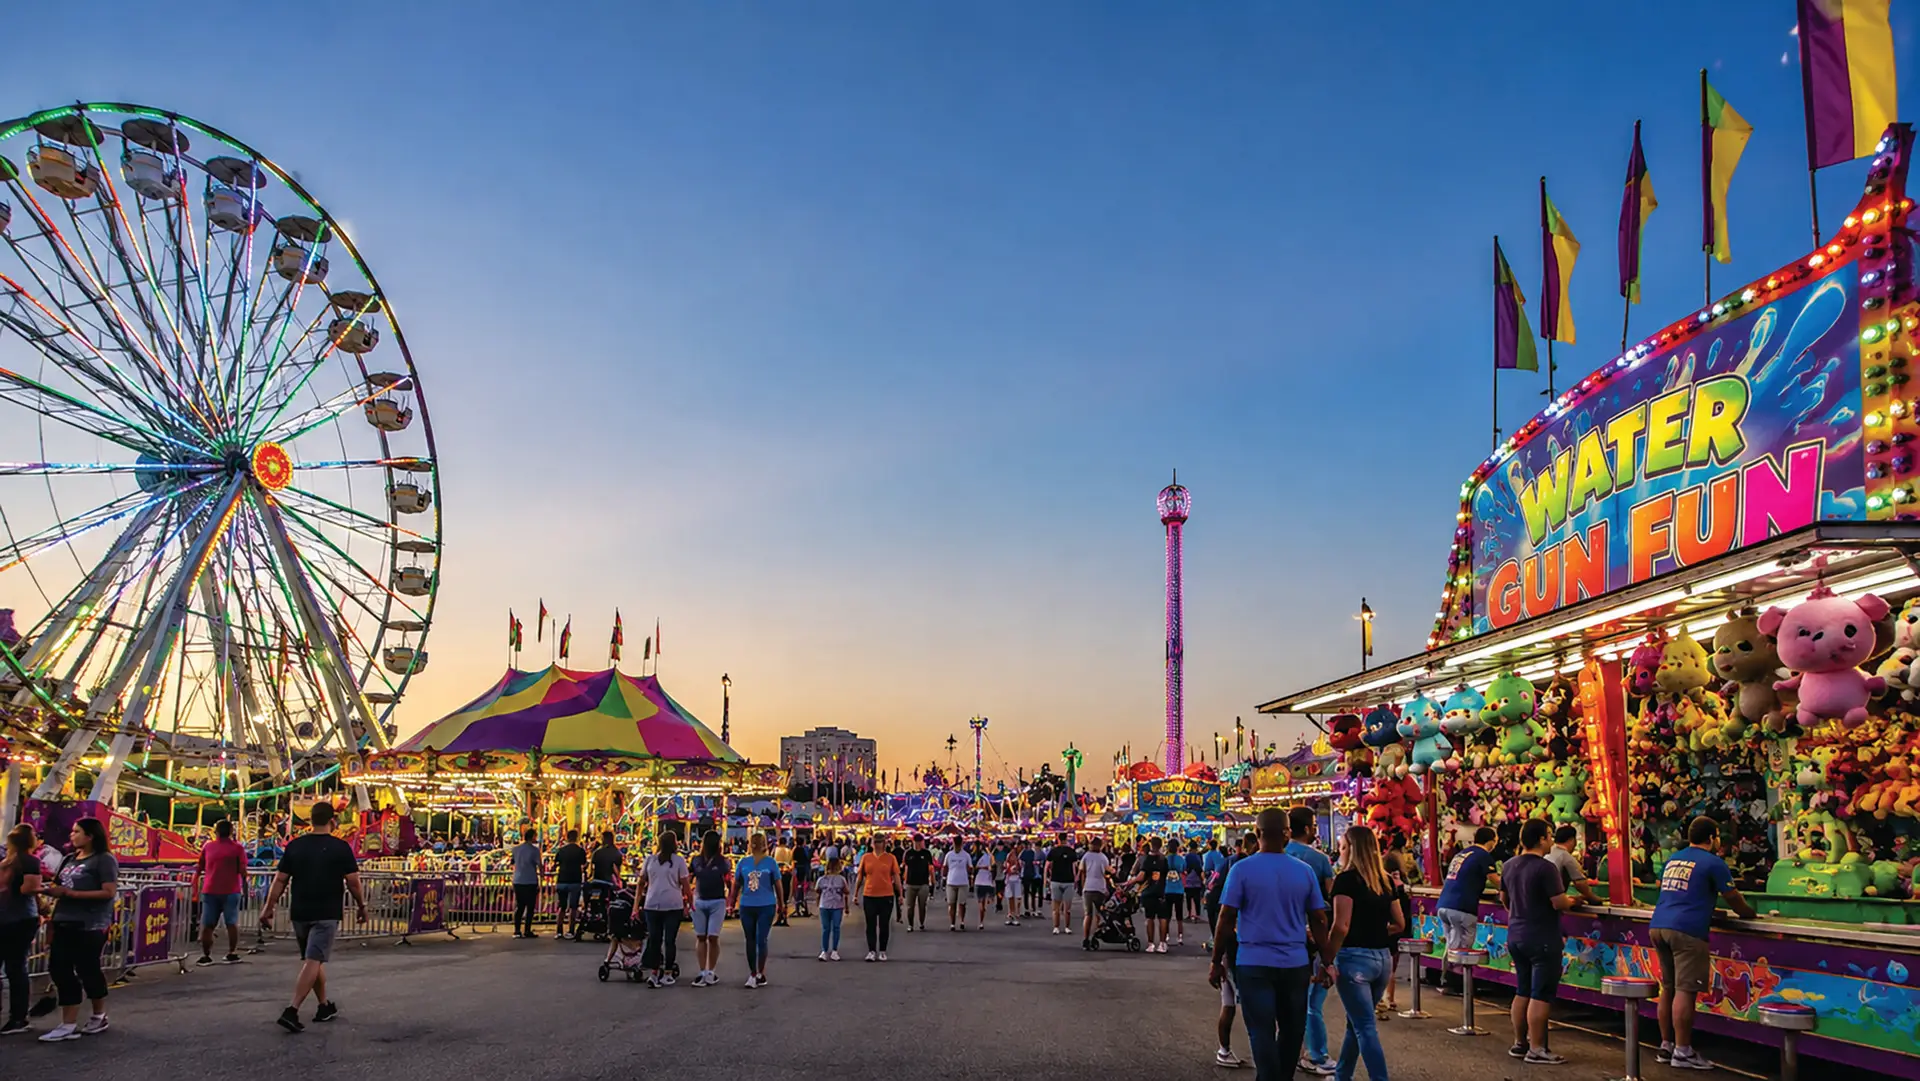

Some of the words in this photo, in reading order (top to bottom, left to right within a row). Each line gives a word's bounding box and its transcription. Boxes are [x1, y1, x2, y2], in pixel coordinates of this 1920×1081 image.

[1488, 522, 1609, 629] GUN
[1628, 440, 1825, 584] FUN
[1519, 374, 1751, 547] WATER
